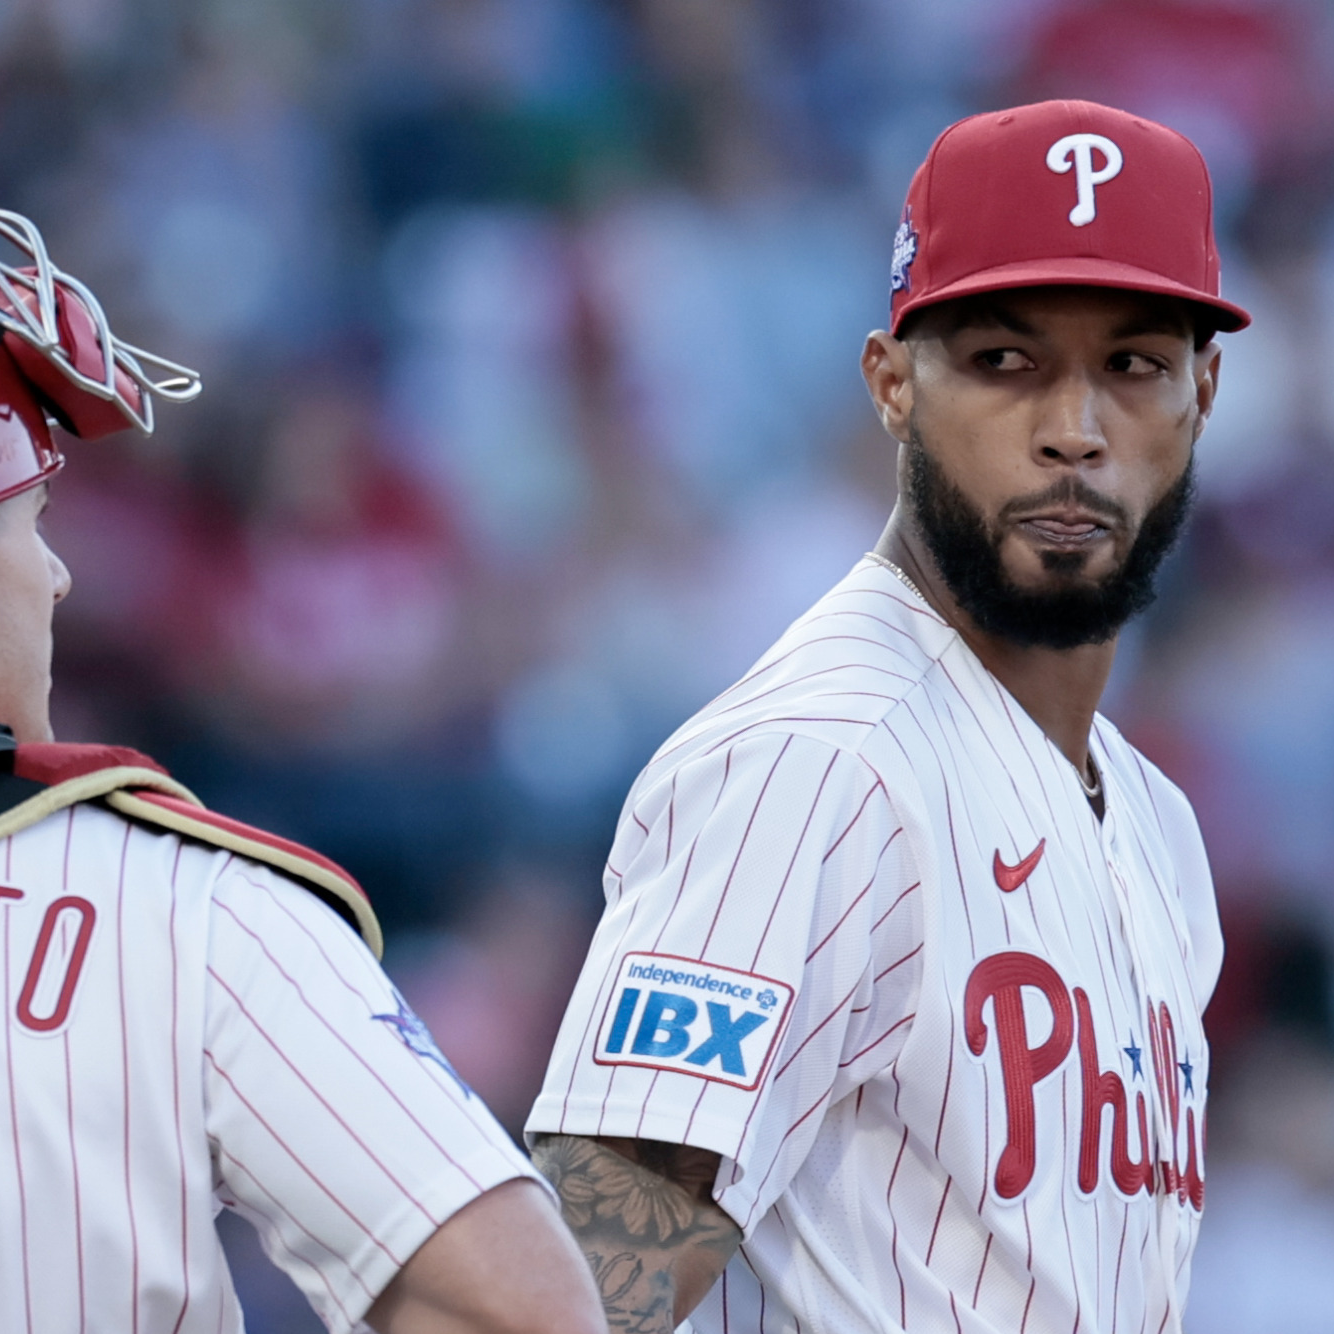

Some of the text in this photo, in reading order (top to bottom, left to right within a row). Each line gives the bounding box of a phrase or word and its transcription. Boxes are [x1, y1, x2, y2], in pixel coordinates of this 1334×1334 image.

[1046, 133, 1124, 227] P
[627, 962, 753, 1001] Independence
[605, 988, 769, 1078] IBX
[964, 951, 1209, 1213] Philli
